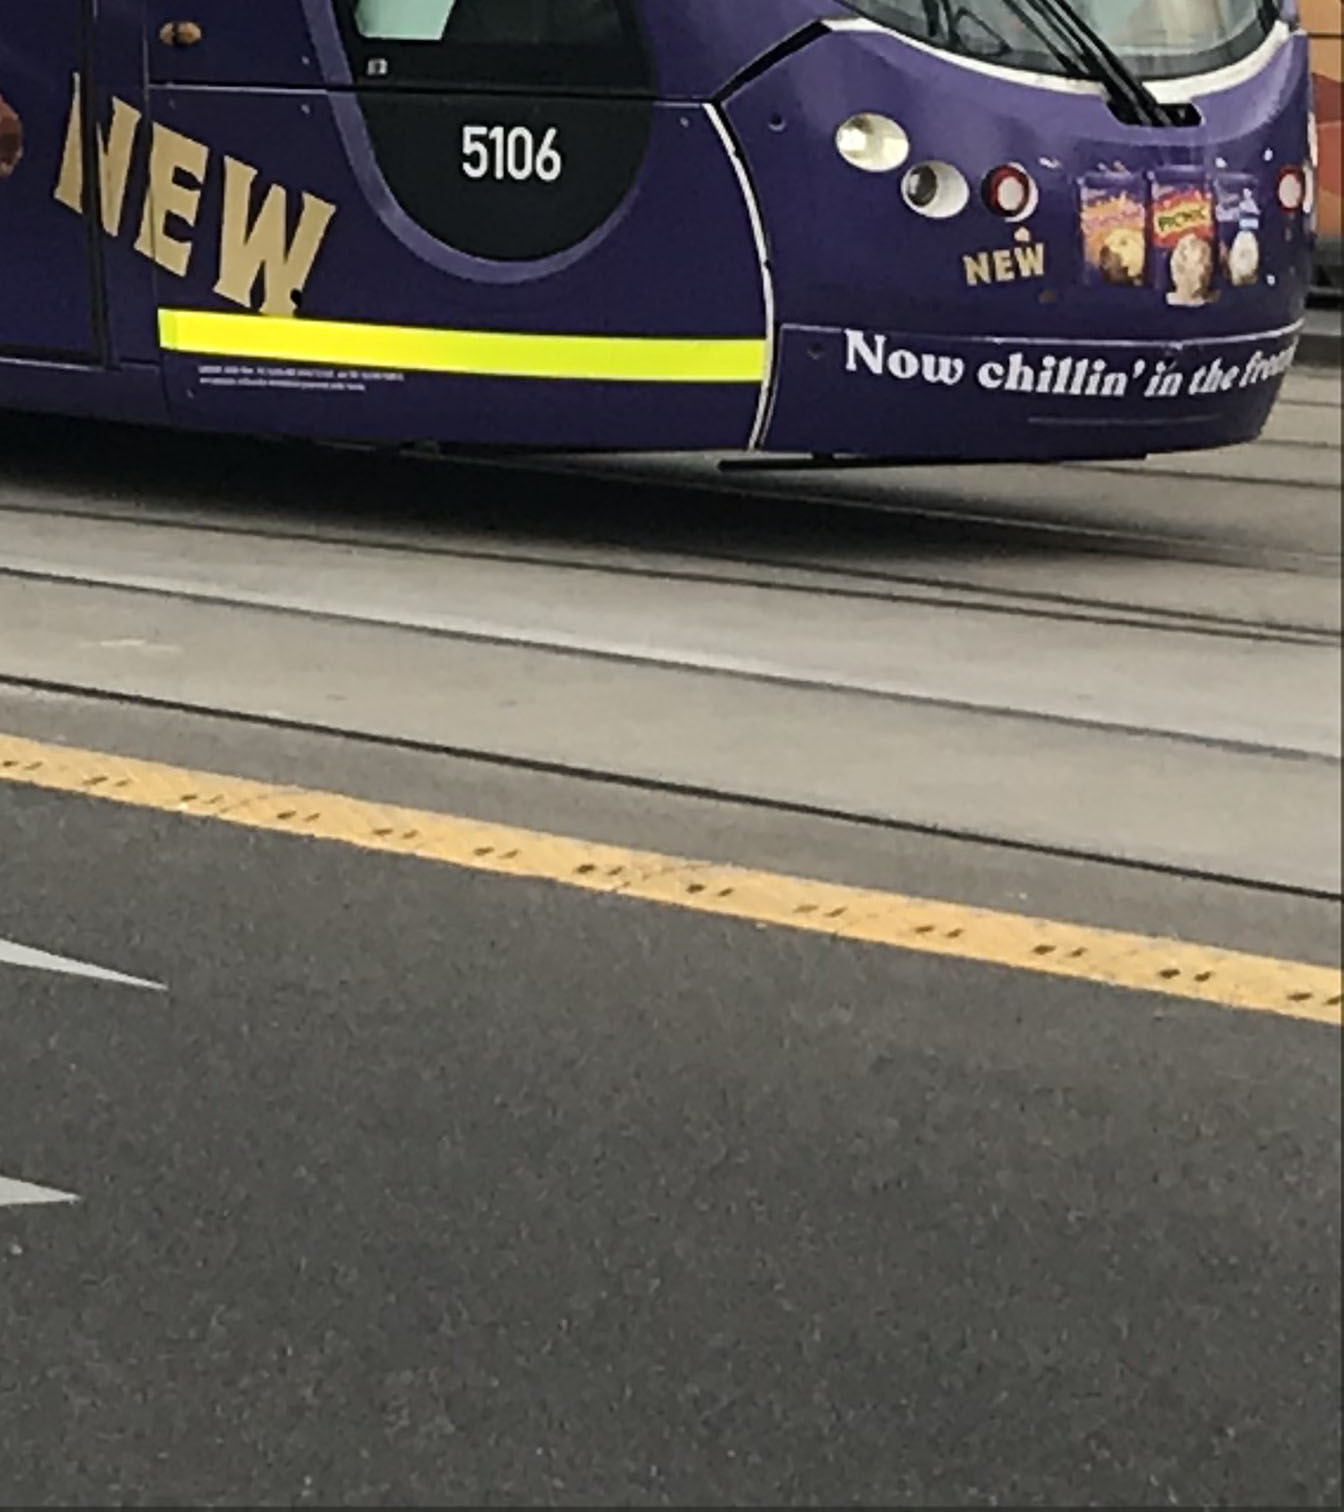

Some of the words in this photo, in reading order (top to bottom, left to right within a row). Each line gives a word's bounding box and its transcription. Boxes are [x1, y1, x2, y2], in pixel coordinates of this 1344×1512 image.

[461, 124, 563, 181] 5106
[53, 72, 337, 317] NEW
[962, 242, 1045, 286] NEW
[843, 328, 965, 385] Now
[976, 352, 1146, 399] chillin'
[1143, 360, 1184, 398] in
[1188, 357, 1240, 395] the
